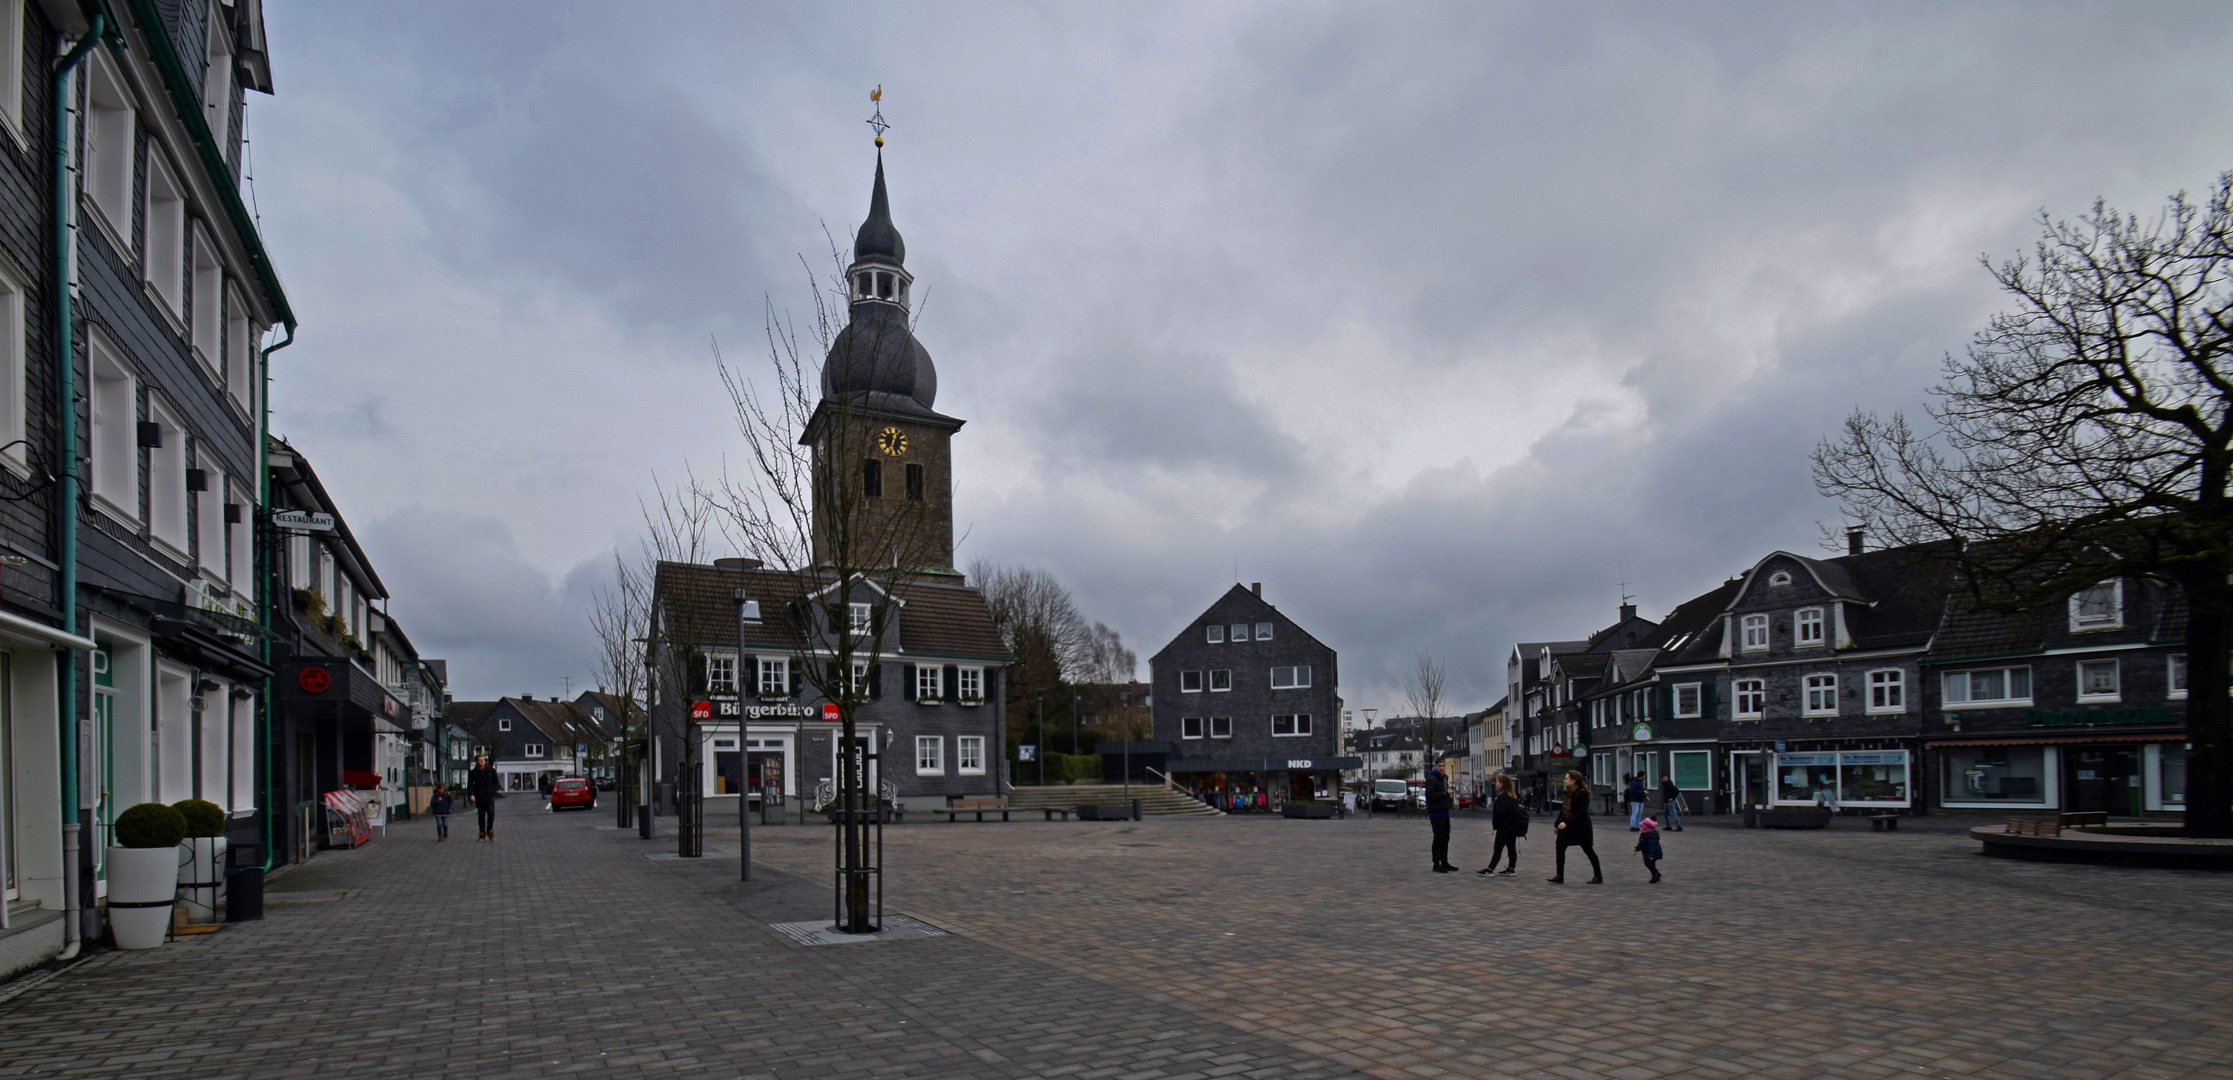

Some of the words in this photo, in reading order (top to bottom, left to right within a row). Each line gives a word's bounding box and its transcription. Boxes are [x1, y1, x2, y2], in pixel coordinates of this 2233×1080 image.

[276, 514, 332, 525] RESTAURANT
[693, 710, 709, 718] SPD
[720, 701, 814, 719] Bürgerbüro
[824, 712, 838, 720] SPD
[1288, 759, 1312, 769] NKD
